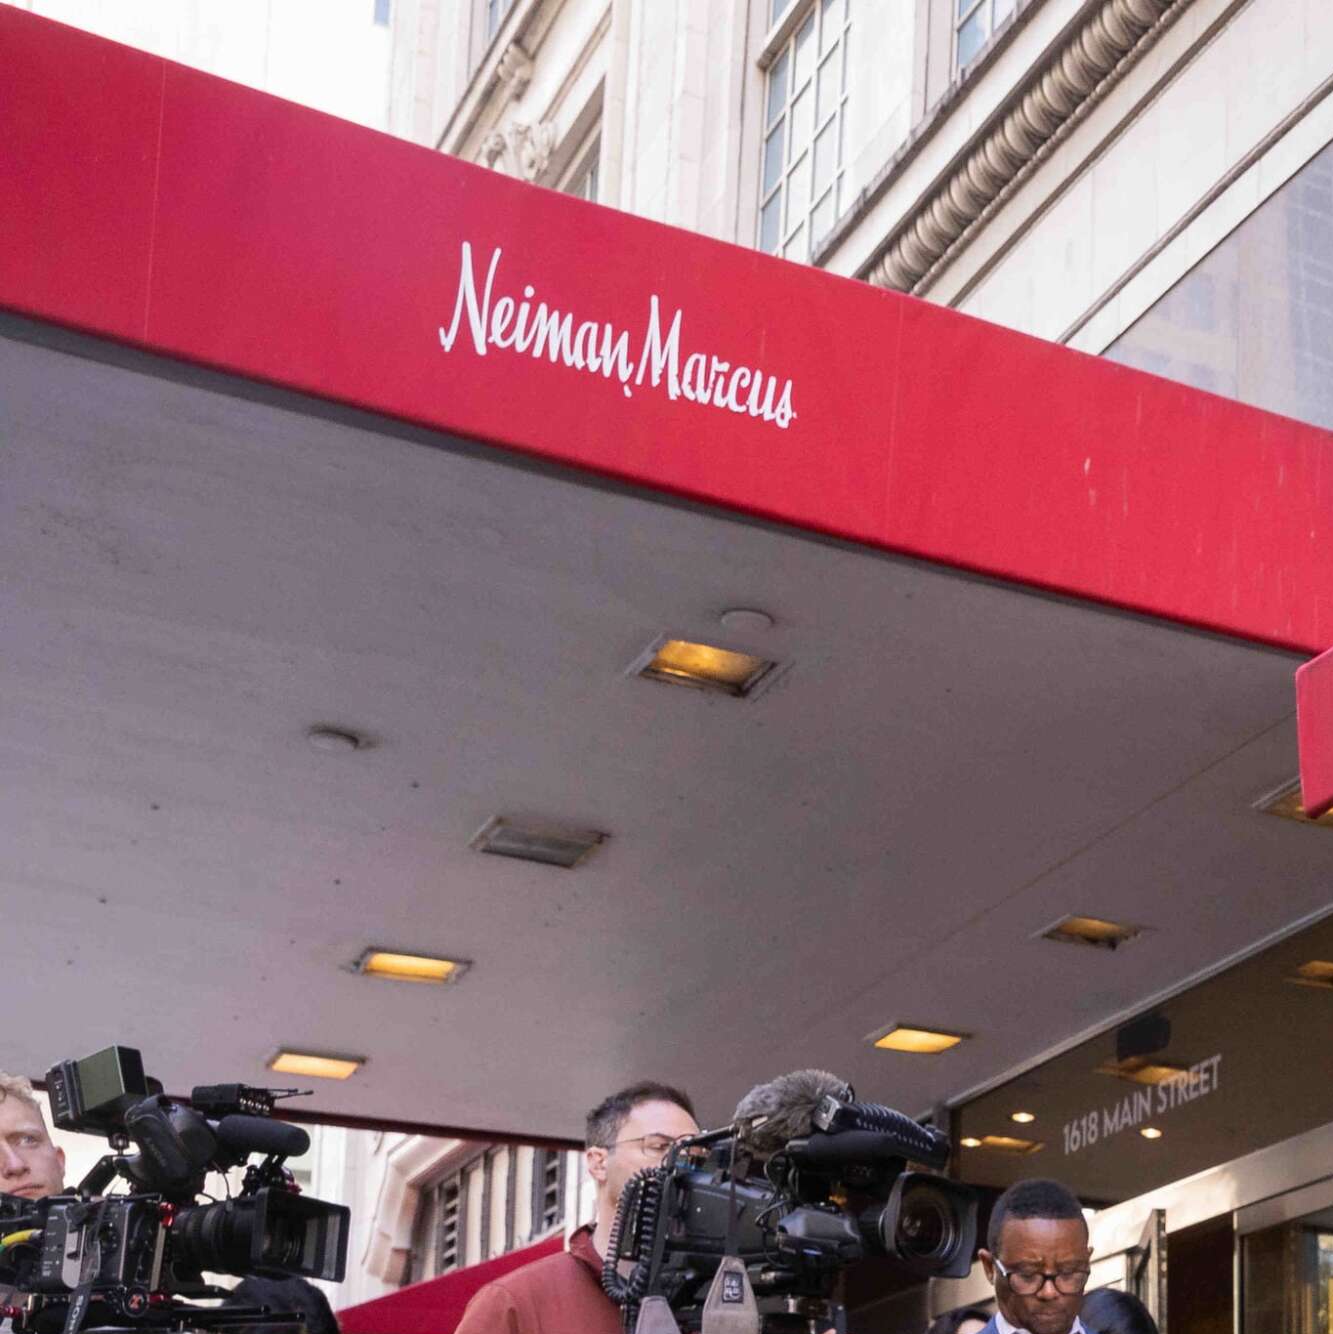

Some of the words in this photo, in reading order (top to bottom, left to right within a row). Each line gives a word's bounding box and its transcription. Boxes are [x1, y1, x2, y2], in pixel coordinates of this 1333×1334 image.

[439, 241, 634, 397] Neiman
[635, 294, 797, 429] Marcus
[1063, 1111, 1099, 1155] 1618
[1103, 1086, 1152, 1138] MAIN
[1157, 1053, 1222, 1114] STREET
